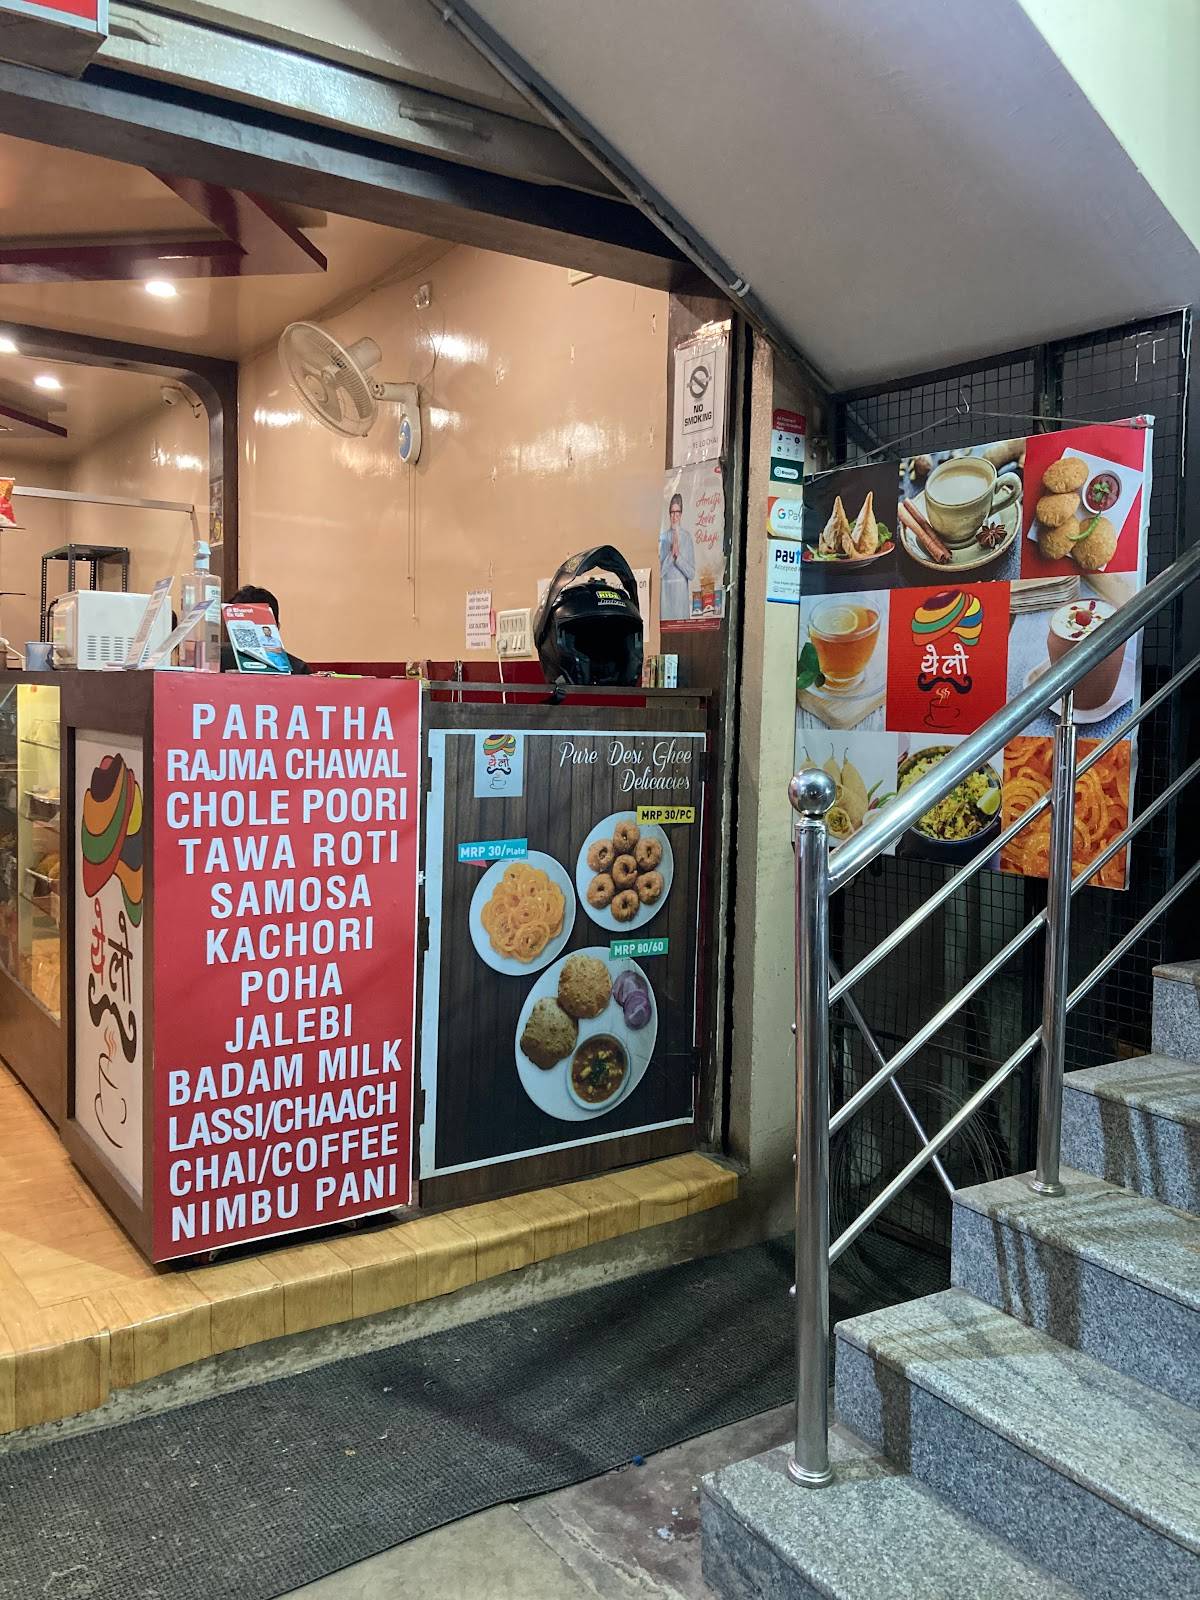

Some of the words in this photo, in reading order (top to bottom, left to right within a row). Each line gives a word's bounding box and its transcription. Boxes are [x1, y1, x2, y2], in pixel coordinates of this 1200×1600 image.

[684, 411, 712, 427] SMOKING
[693, 404, 704, 414] NO
[921, 643, 939, 676] ये
[941, 643, 969, 675] लो
[192, 703, 394, 741] PARATHA
[167, 749, 278, 782] RAJMA
[285, 748, 407, 780] CHAWAL
[559, 741, 598, 768] Pure
[607, 740, 644, 767] Desi
[653, 738, 692, 773] Ghee
[620, 765, 690, 793] Delicacies
[166, 789, 290, 830] CHOLE
[303, 787, 407, 824] POORI
[641, 810, 663, 821] MRP
[664, 809, 692, 820] 30/PC
[178, 834, 296, 875] TAWA
[313, 829, 398, 867] ROTI
[460, 846, 486, 859] MRP
[488, 844, 526, 857] 30/Plate
[210, 873, 372, 919] SAMOSA
[206, 916, 373, 965] KACHORI
[614, 944, 636, 956] MRP
[241, 962, 343, 1007] POHA
[225, 1003, 352, 1053] JALEBI
[168, 1052, 304, 1107] BADAM
[318, 1038, 402, 1084] MILK
[168, 1081, 397, 1152] LASSI/CHAACH
[169, 1121, 399, 1197] CHAI/COFFEE
[171, 1182, 300, 1243] NIMBU
[315, 1163, 397, 1212] PANI
